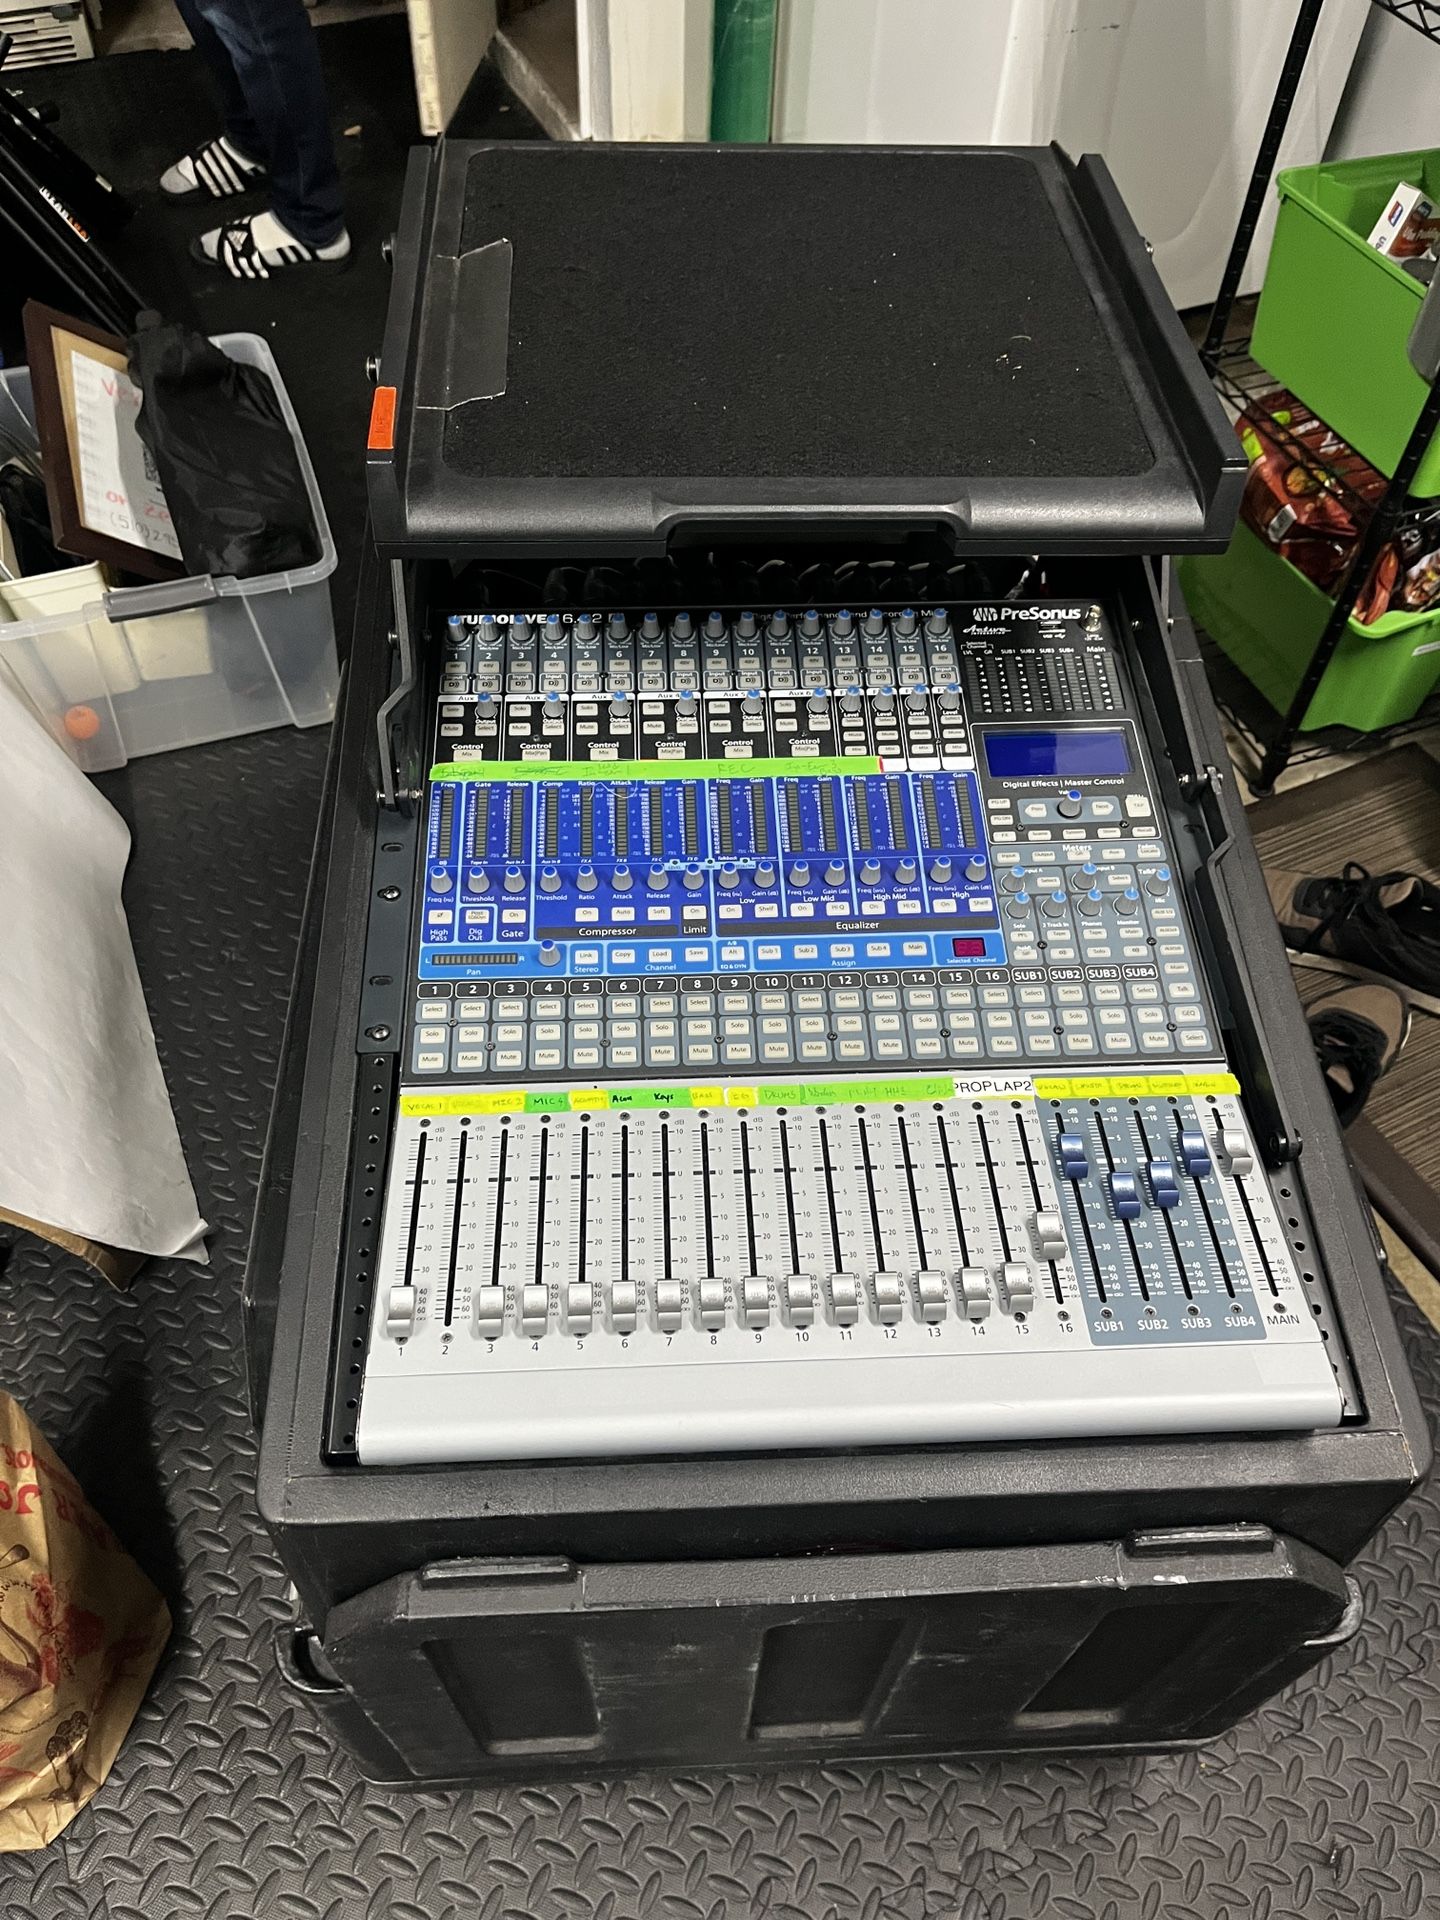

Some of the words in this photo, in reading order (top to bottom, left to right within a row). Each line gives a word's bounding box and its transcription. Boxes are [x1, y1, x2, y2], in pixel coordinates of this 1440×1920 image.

[1000, 606, 1082, 621] PreSonus
[743, 648, 755, 656] 10
[774, 648, 786, 656] 11
[807, 647, 819, 655] 12
[902, 645, 915, 653] 15
[934, 644, 947, 652] 16
[550, 651, 558, 659] 4
[615, 650, 623, 658] 6
[648, 650, 655, 658] 7
[680, 650, 687, 658] 8
[519, 742, 552, 750] Control
[587, 741, 620, 749] Control
[655, 740, 687, 748] Control
[722, 739, 754, 747] Control
[1002, 780, 1029, 789] Digital
[1031, 780, 1058, 788] Effects
[1064, 778, 1092, 786] Master
[1094, 777, 1125, 785] Control
[1062, 844, 1093, 852] Meters
[462, 895, 495, 903] Threshold
[802, 895, 819, 903] Low
[872, 893, 891, 902] High
[951, 891, 970, 900] High
[683, 925, 707, 934] Limit
[835, 920, 880, 930] Equalizer
[429, 928, 449, 937] High
[468, 927, 483, 936] Dig
[501, 929, 524, 938] Gate
[578, 927, 637, 938] Compressor
[430, 934, 448, 942] Pass
[467, 934, 483, 942] Out
[615, 951, 631, 959] Copy
[644, 963, 677, 972] Channel
[831, 959, 856, 968] Assign
[574, 966, 599, 974] Stereo
[1088, 969, 1118, 979] SUB3
[1125, 968, 1155, 978] SUB4
[875, 975, 889, 984] 13
[912, 974, 926, 983] 14
[949, 972, 963, 982] 15
[985, 971, 1000, 981] 16
[1014, 971, 1043, 981] SUB1
[1051, 970, 1081, 980] SUB2
[694, 980, 701, 989] 8
[731, 979, 738, 988] 9
[765, 978, 779, 987] 10
[802, 977, 814, 986] 11
[838, 976, 852, 985] 12
[469, 985, 477, 994] 2
[507, 984, 515, 994] 3
[544, 983, 553, 992] 4
[582, 983, 590, 992] 5
[619, 981, 627, 991] 6
[657, 981, 664, 990] 7
[533, 1097, 556, 1106] MIC
[653, 1092, 674, 1103] Keys
[1137, 1319, 1169, 1330] SUB2
[1180, 1318, 1213, 1329] SUB3
[1224, 1316, 1256, 1327] SUB4
[1266, 1314, 1300, 1326] MAIN
[1015, 1325, 1030, 1335] 15
[1059, 1323, 1074, 1333] 16
[1093, 1320, 1124, 1332] SUB1
[840, 1330, 852, 1341] 11
[883, 1329, 898, 1340] 12
[928, 1327, 942, 1338] 13
[971, 1326, 986, 1336] 14
[710, 1336, 717, 1345] 8
[755, 1333, 762, 1344] 9
[796, 1332, 810, 1342] 10
[577, 1340, 584, 1350] 5
[621, 1339, 629, 1348] 6
[666, 1337, 673, 1347] 7
[441, 1345, 448, 1355] 2
[486, 1343, 494, 1354] 3
[531, 1342, 540, 1352] 4
